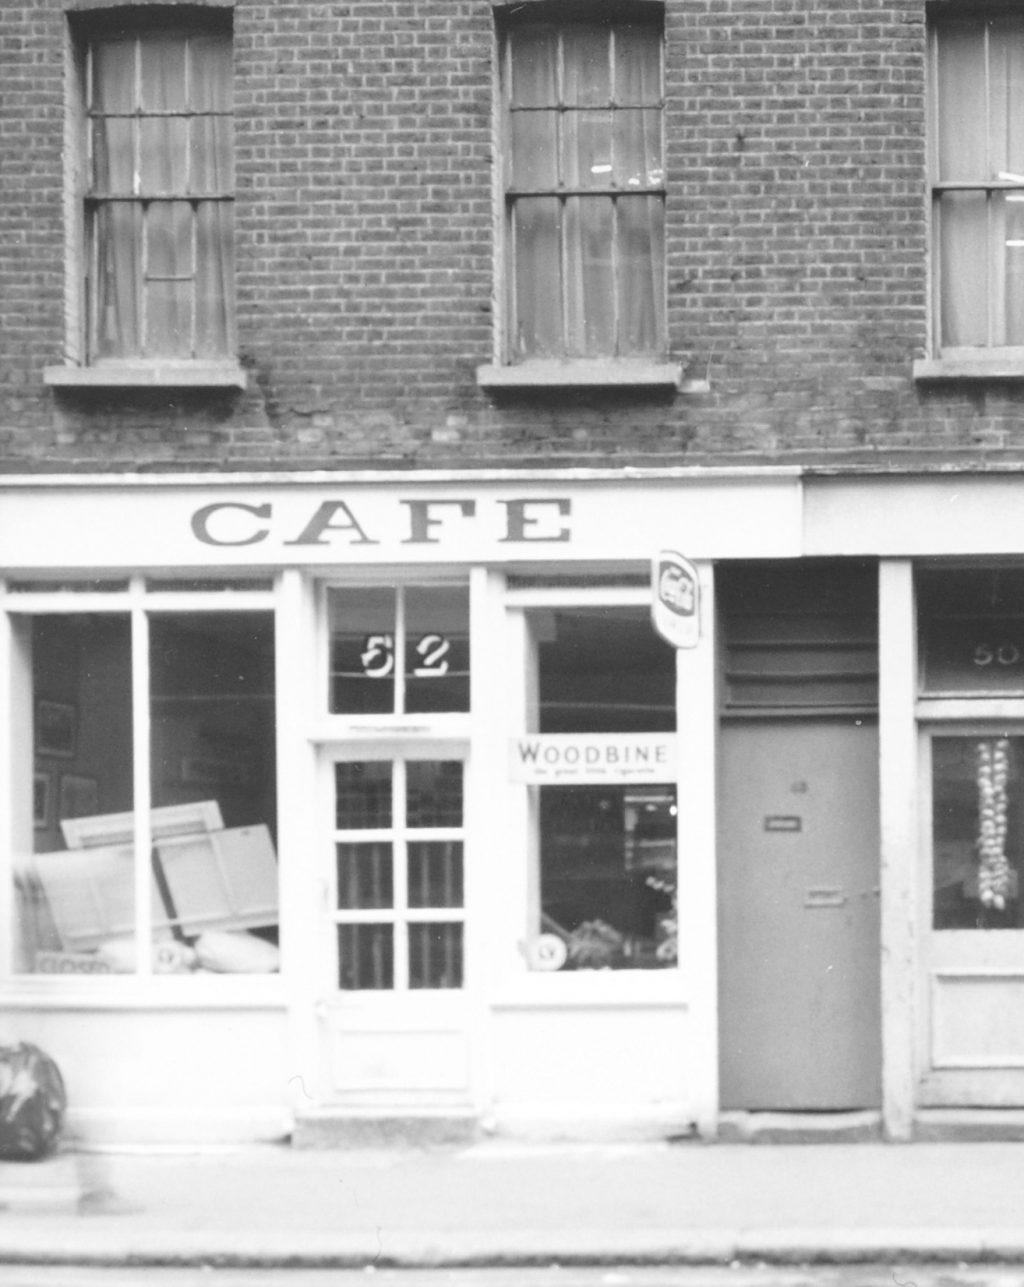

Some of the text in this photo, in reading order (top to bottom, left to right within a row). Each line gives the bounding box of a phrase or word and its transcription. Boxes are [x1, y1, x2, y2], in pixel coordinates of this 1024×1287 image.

[190, 497, 573, 546] CAFE
[360, 633, 451, 677] 52
[973, 642, 1020, 666] 50
[517, 741, 668, 764] WOODBINE
